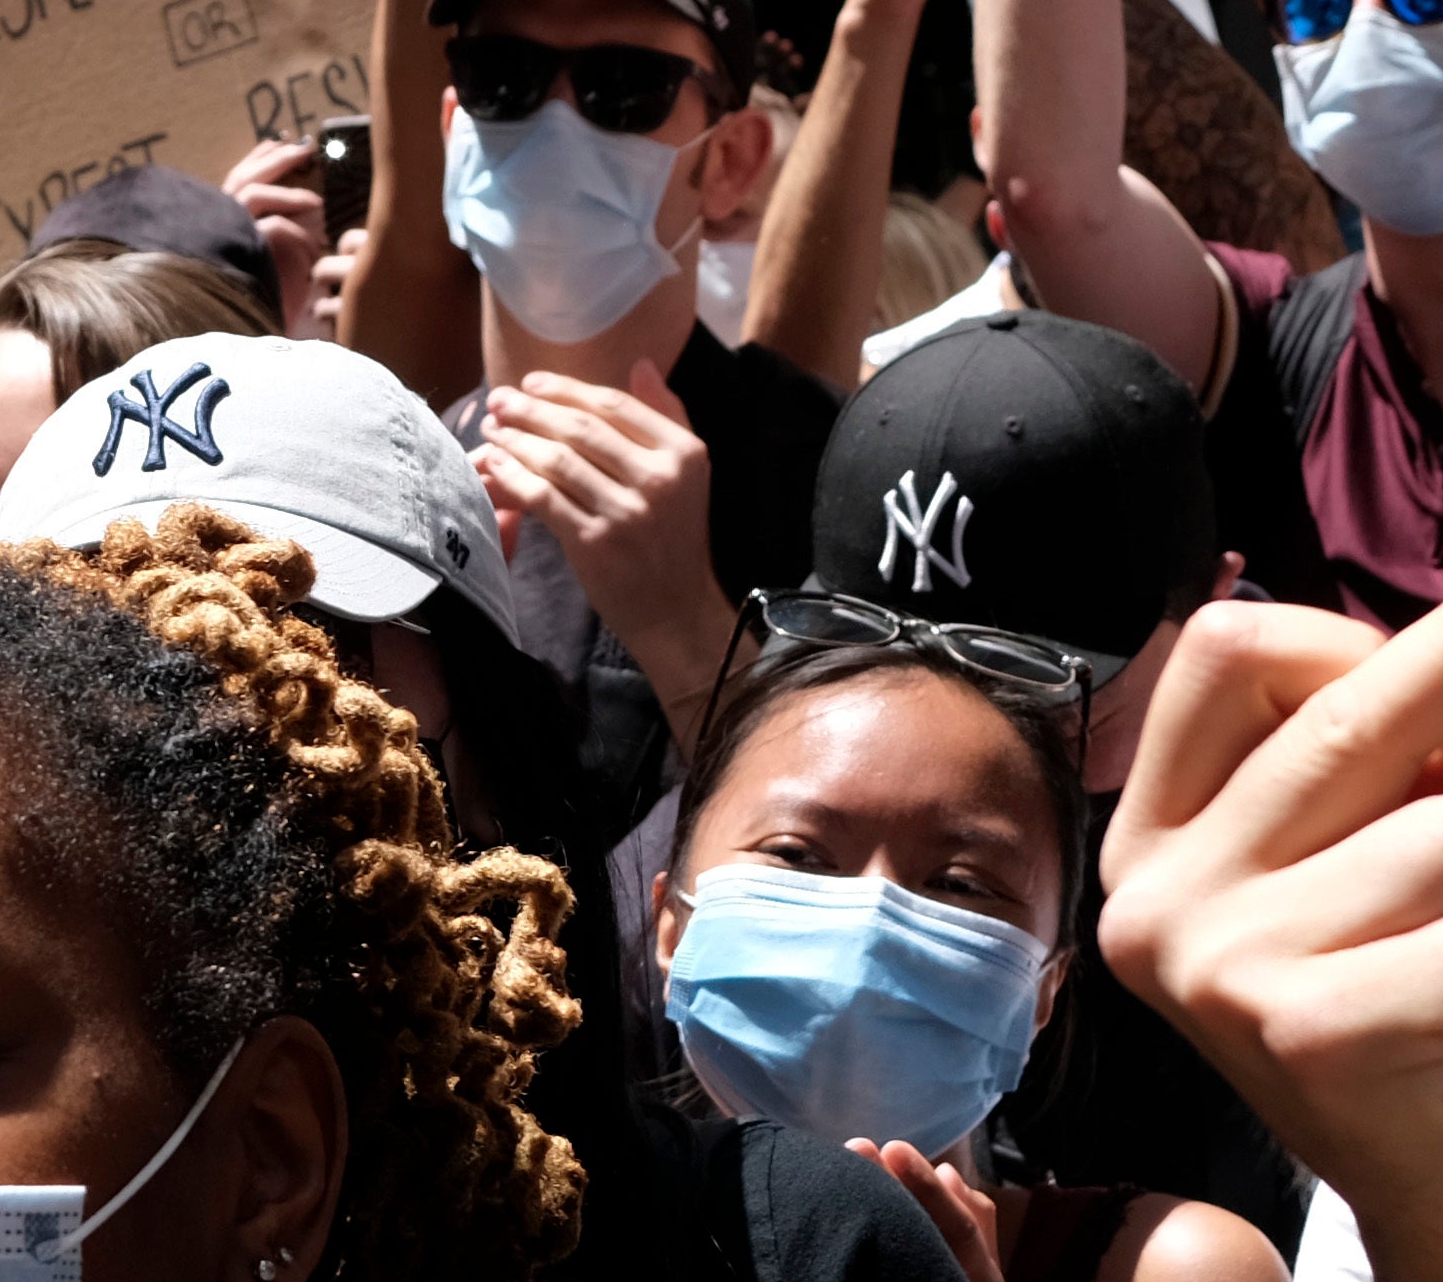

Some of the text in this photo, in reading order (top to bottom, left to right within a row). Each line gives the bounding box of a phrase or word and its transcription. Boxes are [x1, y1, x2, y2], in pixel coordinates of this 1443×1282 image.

[177, 0, 242, 55] OR
[92, 361, 232, 478] NY
[878, 469, 975, 593] NY
